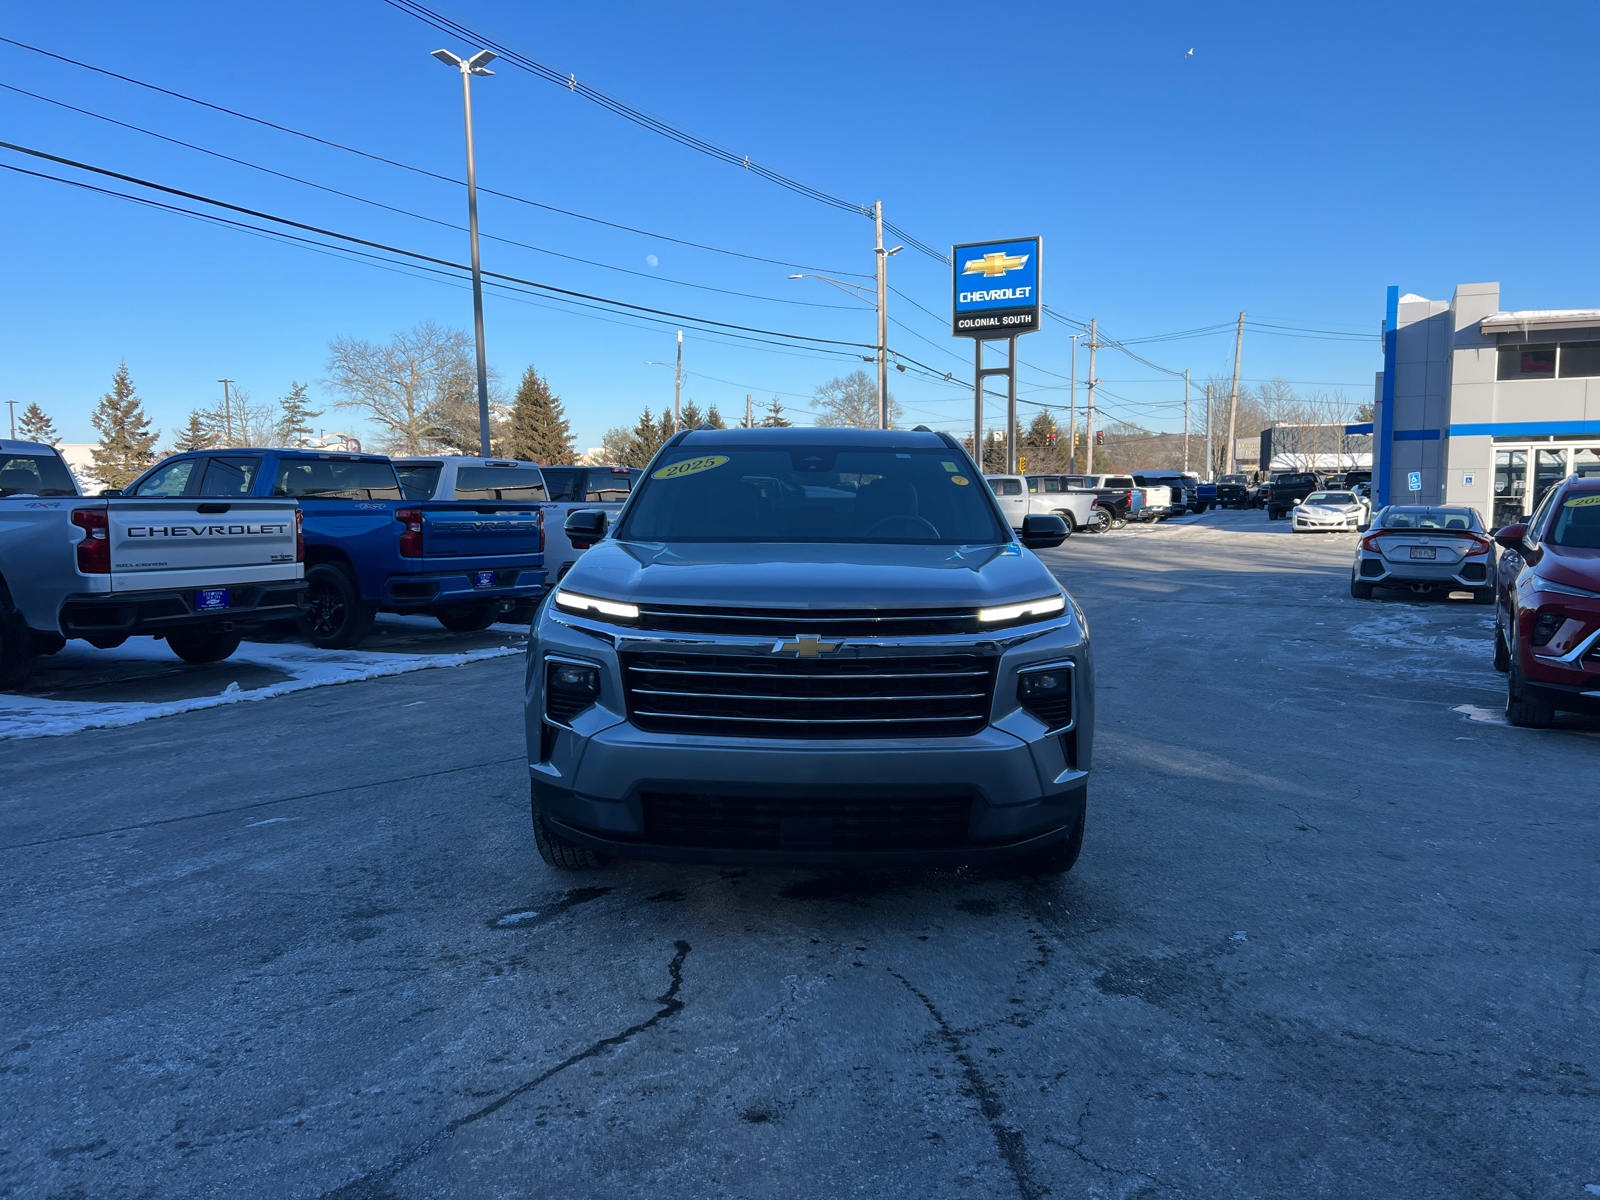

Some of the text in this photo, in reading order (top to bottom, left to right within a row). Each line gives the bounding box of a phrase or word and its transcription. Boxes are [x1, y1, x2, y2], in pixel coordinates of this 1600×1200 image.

[960, 286, 1032, 303] CHEVROLET
[958, 315, 1032, 328] COLONIAL SOUTH
[665, 457, 716, 477] 2025
[127, 524, 288, 538] CHEVROLET
[433, 521, 537, 532] CHEVROLET
